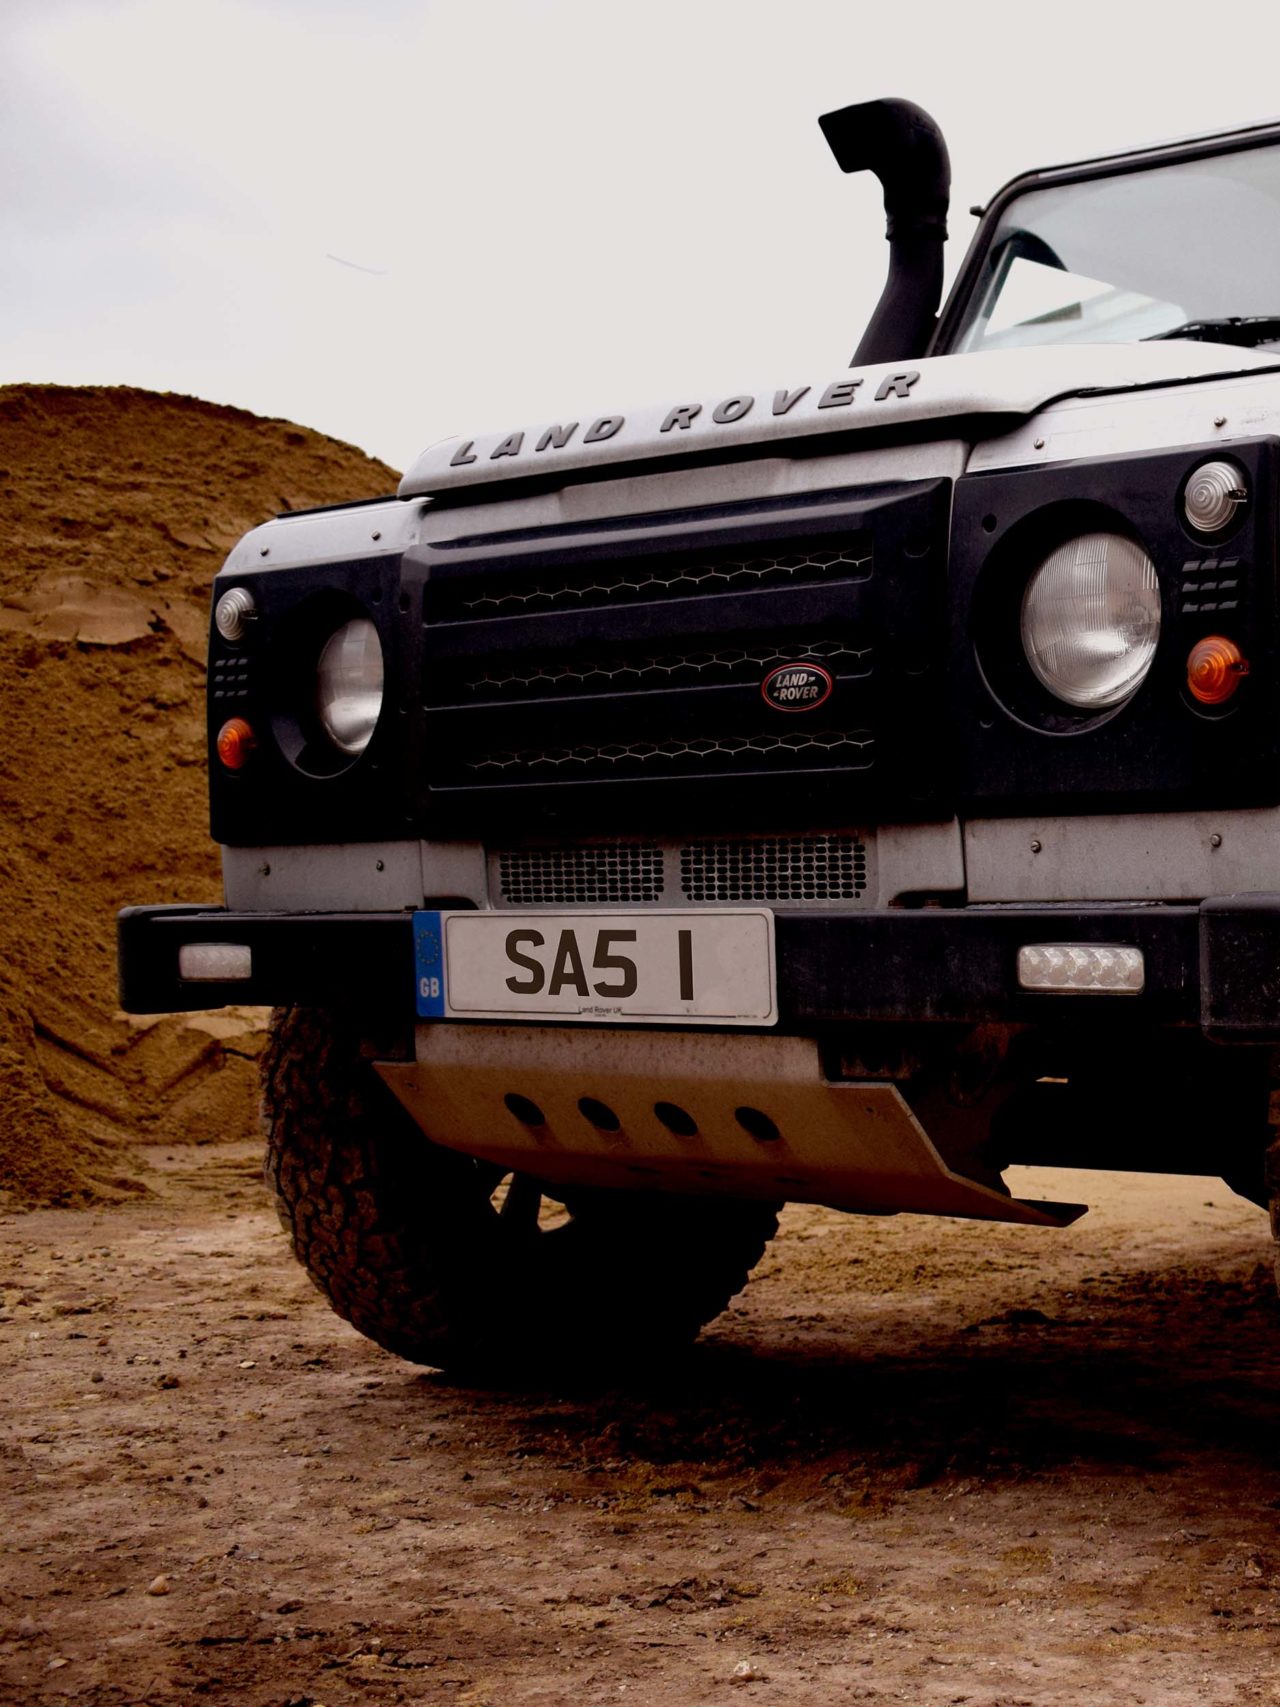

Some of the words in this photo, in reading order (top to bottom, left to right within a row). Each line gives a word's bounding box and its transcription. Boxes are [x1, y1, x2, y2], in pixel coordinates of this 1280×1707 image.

[449, 415, 625, 467] LAND
[660, 370, 921, 434] ROVER
[776, 673, 809, 687] LAND
[779, 686, 819, 700] ROVER
[419, 977, 440, 998] GB
[578, 1005, 593, 1014] Land
[594, 1006, 612, 1014] Rover
[613, 1006, 622, 1014] UK
